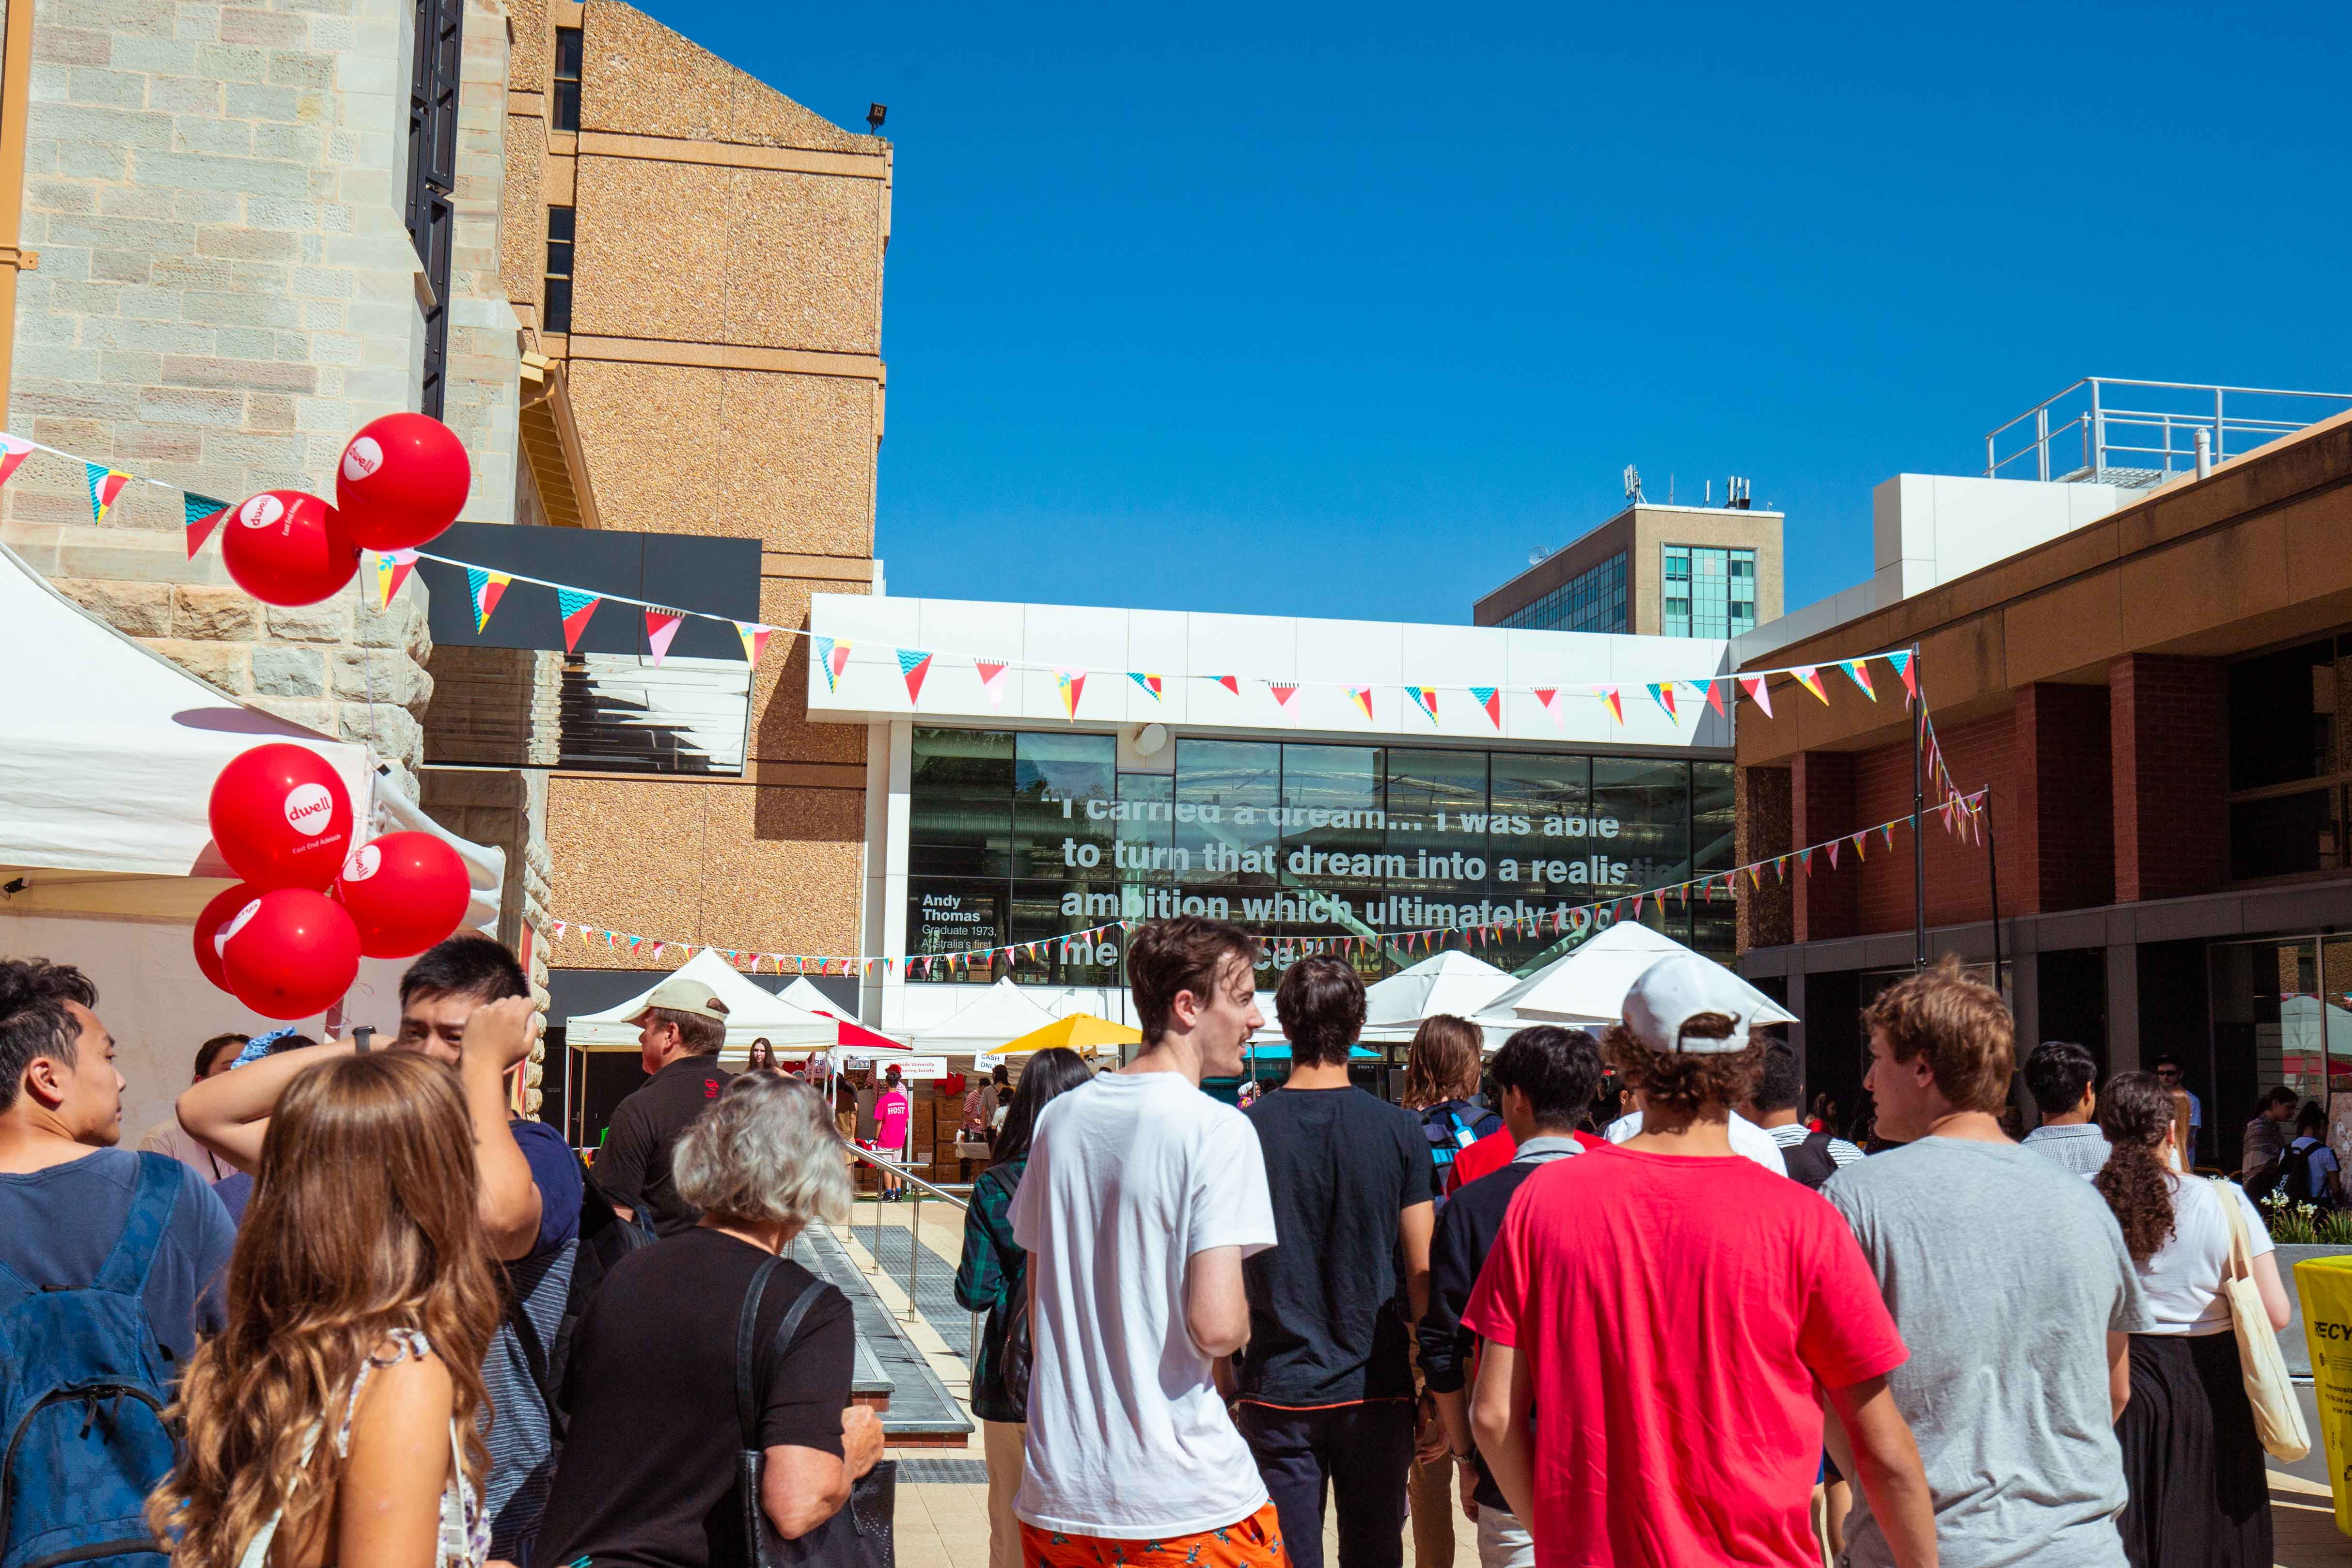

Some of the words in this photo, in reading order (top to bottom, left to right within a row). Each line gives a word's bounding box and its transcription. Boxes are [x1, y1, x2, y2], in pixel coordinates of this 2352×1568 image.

[250, 497, 271, 526] dwell
[289, 796, 331, 821] dwell
[1085, 792, 1220, 823] carried
[1234, 801, 1256, 825] a
[1437, 805, 1446, 831] I
[1459, 811, 1531, 835] was
[1543, 807, 1619, 838] able
[292, 846, 306, 854] East
[307, 840, 319, 849] End
[320, 833, 342, 845] Adelaide
[1062, 838, 1100, 868] to
[1113, 840, 1190, 870] turn
[1202, 842, 1276, 873] that
[1288, 845, 1406, 877] dream
[1418, 849, 1487, 881] into
[1498, 858, 1519, 882] a
[923, 894, 961, 909] Andy
[1061, 887, 1229, 920] ambition
[1241, 892, 1352, 924] which
[1365, 895, 1547, 938] ultimately
[1556, 902, 1613, 931] too
[923, 909, 981, 922] Thomas
[922, 924, 968, 936] Graduate
[972, 926, 997, 938] 1973,
[921, 938, 971, 949] Australia's
[973, 939, 992, 949] first
[1060, 941, 1118, 967] me
[887, 1107, 906, 1115] HOST
